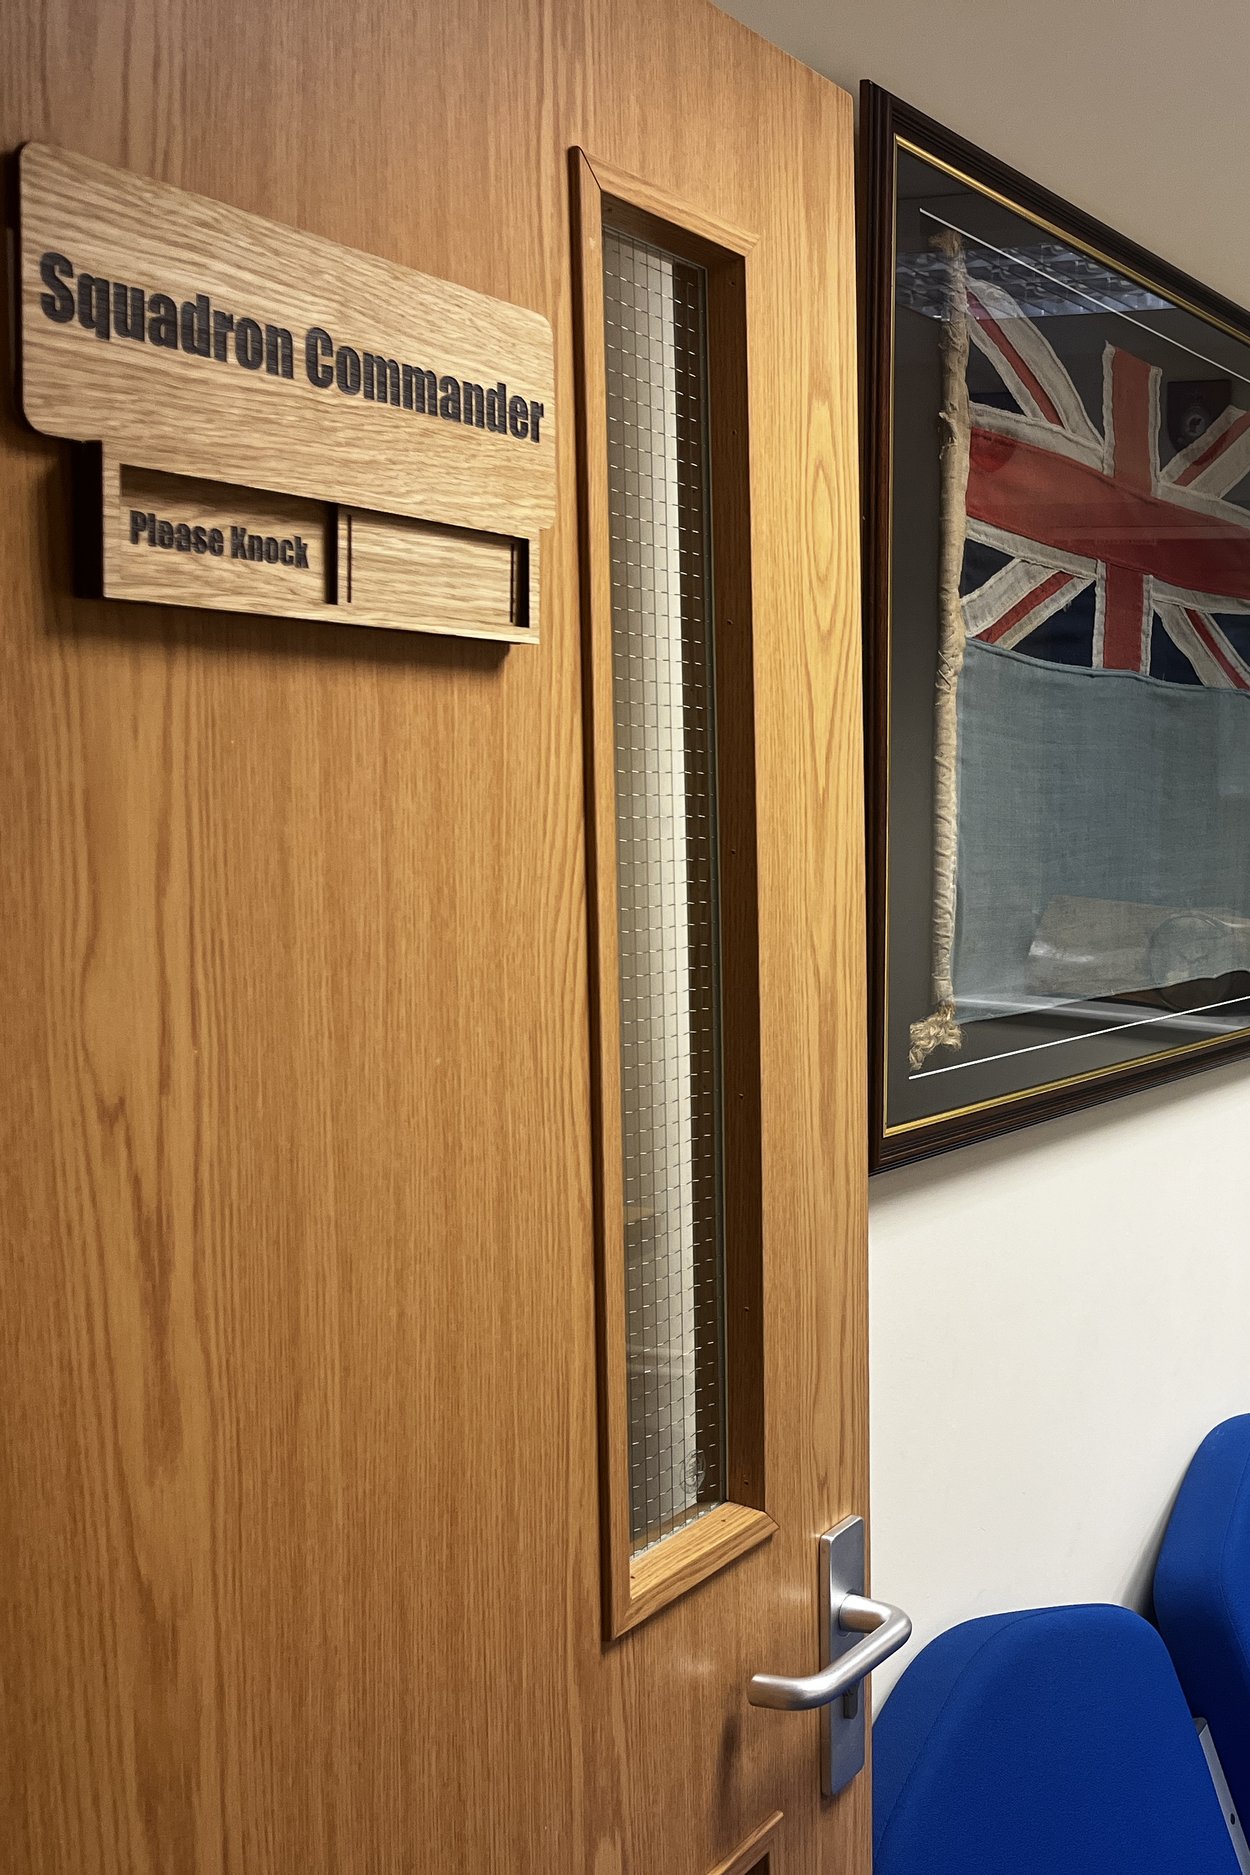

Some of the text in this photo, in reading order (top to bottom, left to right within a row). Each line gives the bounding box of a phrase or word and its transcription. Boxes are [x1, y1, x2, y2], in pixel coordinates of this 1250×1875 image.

[39, 252, 544, 443] Squadron Commander
[130, 509, 310, 569] Please Knock
